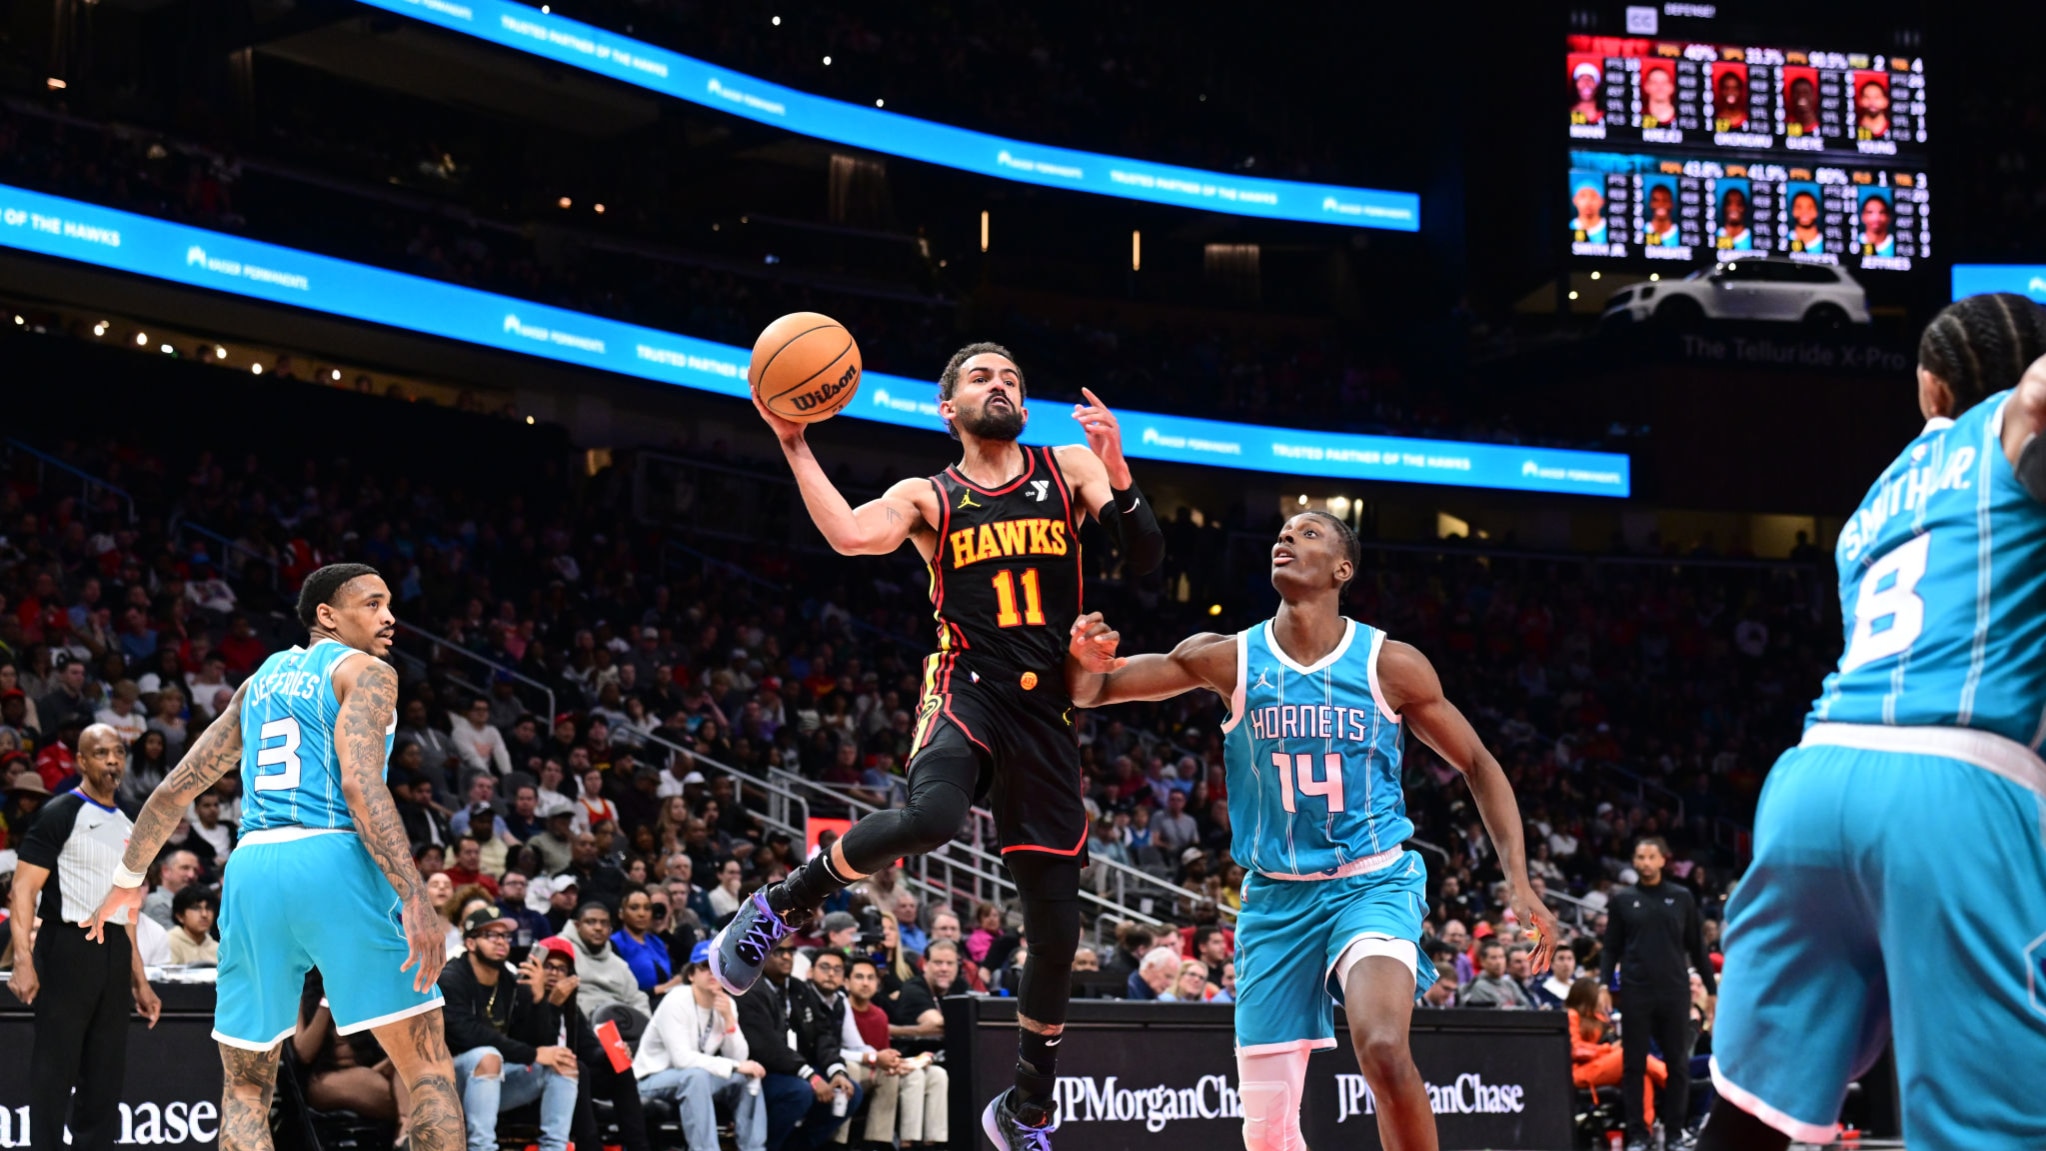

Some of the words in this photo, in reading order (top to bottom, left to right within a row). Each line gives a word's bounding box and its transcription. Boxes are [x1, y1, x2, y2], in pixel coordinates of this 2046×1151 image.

[1873, 54, 1885, 72] 2
[1911, 57, 1924, 74] 4
[1878, 170, 1888, 187] 1
[1916, 172, 1927, 189] 3
[4, 208, 27, 226] OF
[31, 212, 61, 235] THE
[64, 220, 121, 247] HAWKS
[636, 344, 686, 368] TRUSTED
[688, 355, 737, 378] PARTNER
[1682, 334, 1726, 359] The
[1733, 336, 1834, 365] Telluride
[1841, 346, 1906, 371] X-Pro
[790, 364, 857, 412] Wilson
[1272, 443, 1324, 460] TRUSTED
[1325, 448, 1380, 464] PARTNER
[1382, 452, 1399, 465] OF
[1402, 453, 1425, 467] THE
[1427, 456, 1471, 471] HAWKS
[1844, 465, 1931, 561] SMITH
[1927, 446, 1976, 496] JR.
[950, 518, 1068, 569] HAWKS
[992, 567, 1046, 629] 11
[1840, 531, 1931, 674] 8
[251, 670, 320, 707] JEFFRIES
[1251, 705, 1367, 742] HORNETS
[254, 716, 301, 792] 3
[1272, 752, 1344, 813] 14
[1052, 1075, 1245, 1132] JPMorganCh
[1335, 1073, 1525, 1123] JPanChase
